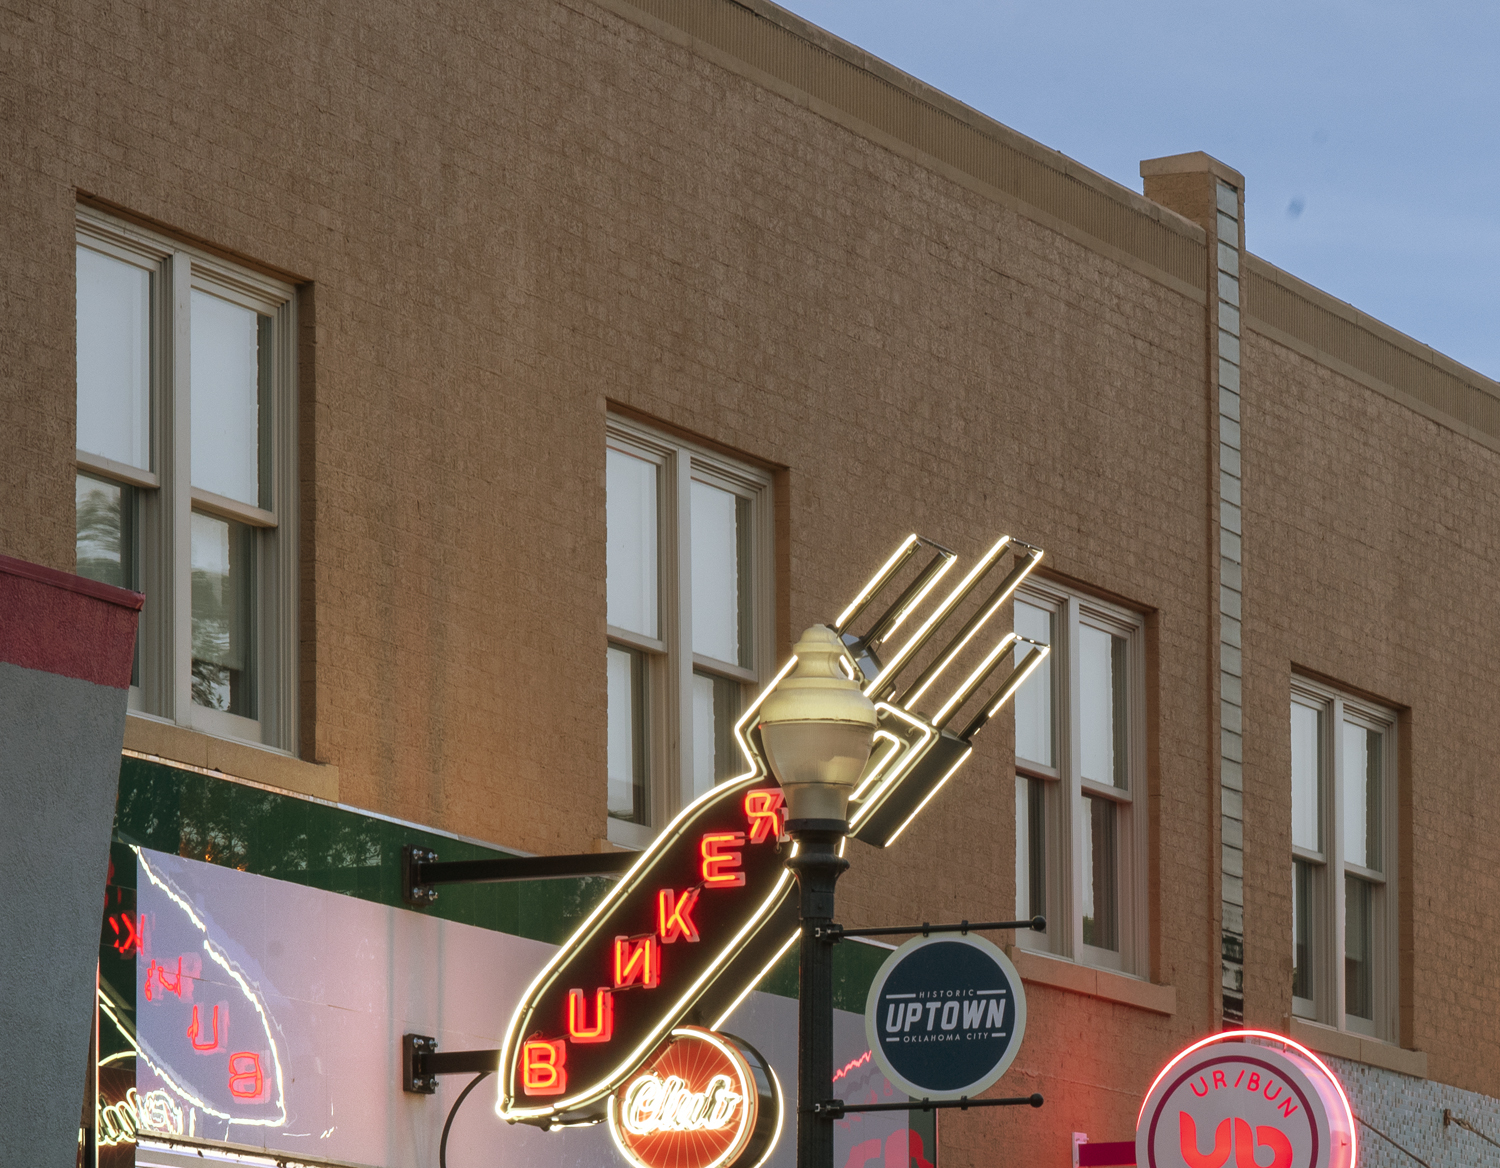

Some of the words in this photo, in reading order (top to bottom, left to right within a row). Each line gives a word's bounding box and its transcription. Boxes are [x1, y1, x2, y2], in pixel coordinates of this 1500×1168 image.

[919, 989, 975, 999] HISTORIC
[886, 998, 1006, 1033] UPTOWN
[903, 1034, 961, 1043] OKLAHOMA
[966, 1032, 989, 1041] CITY
[1189, 1069, 1299, 1119] UR/BUN
